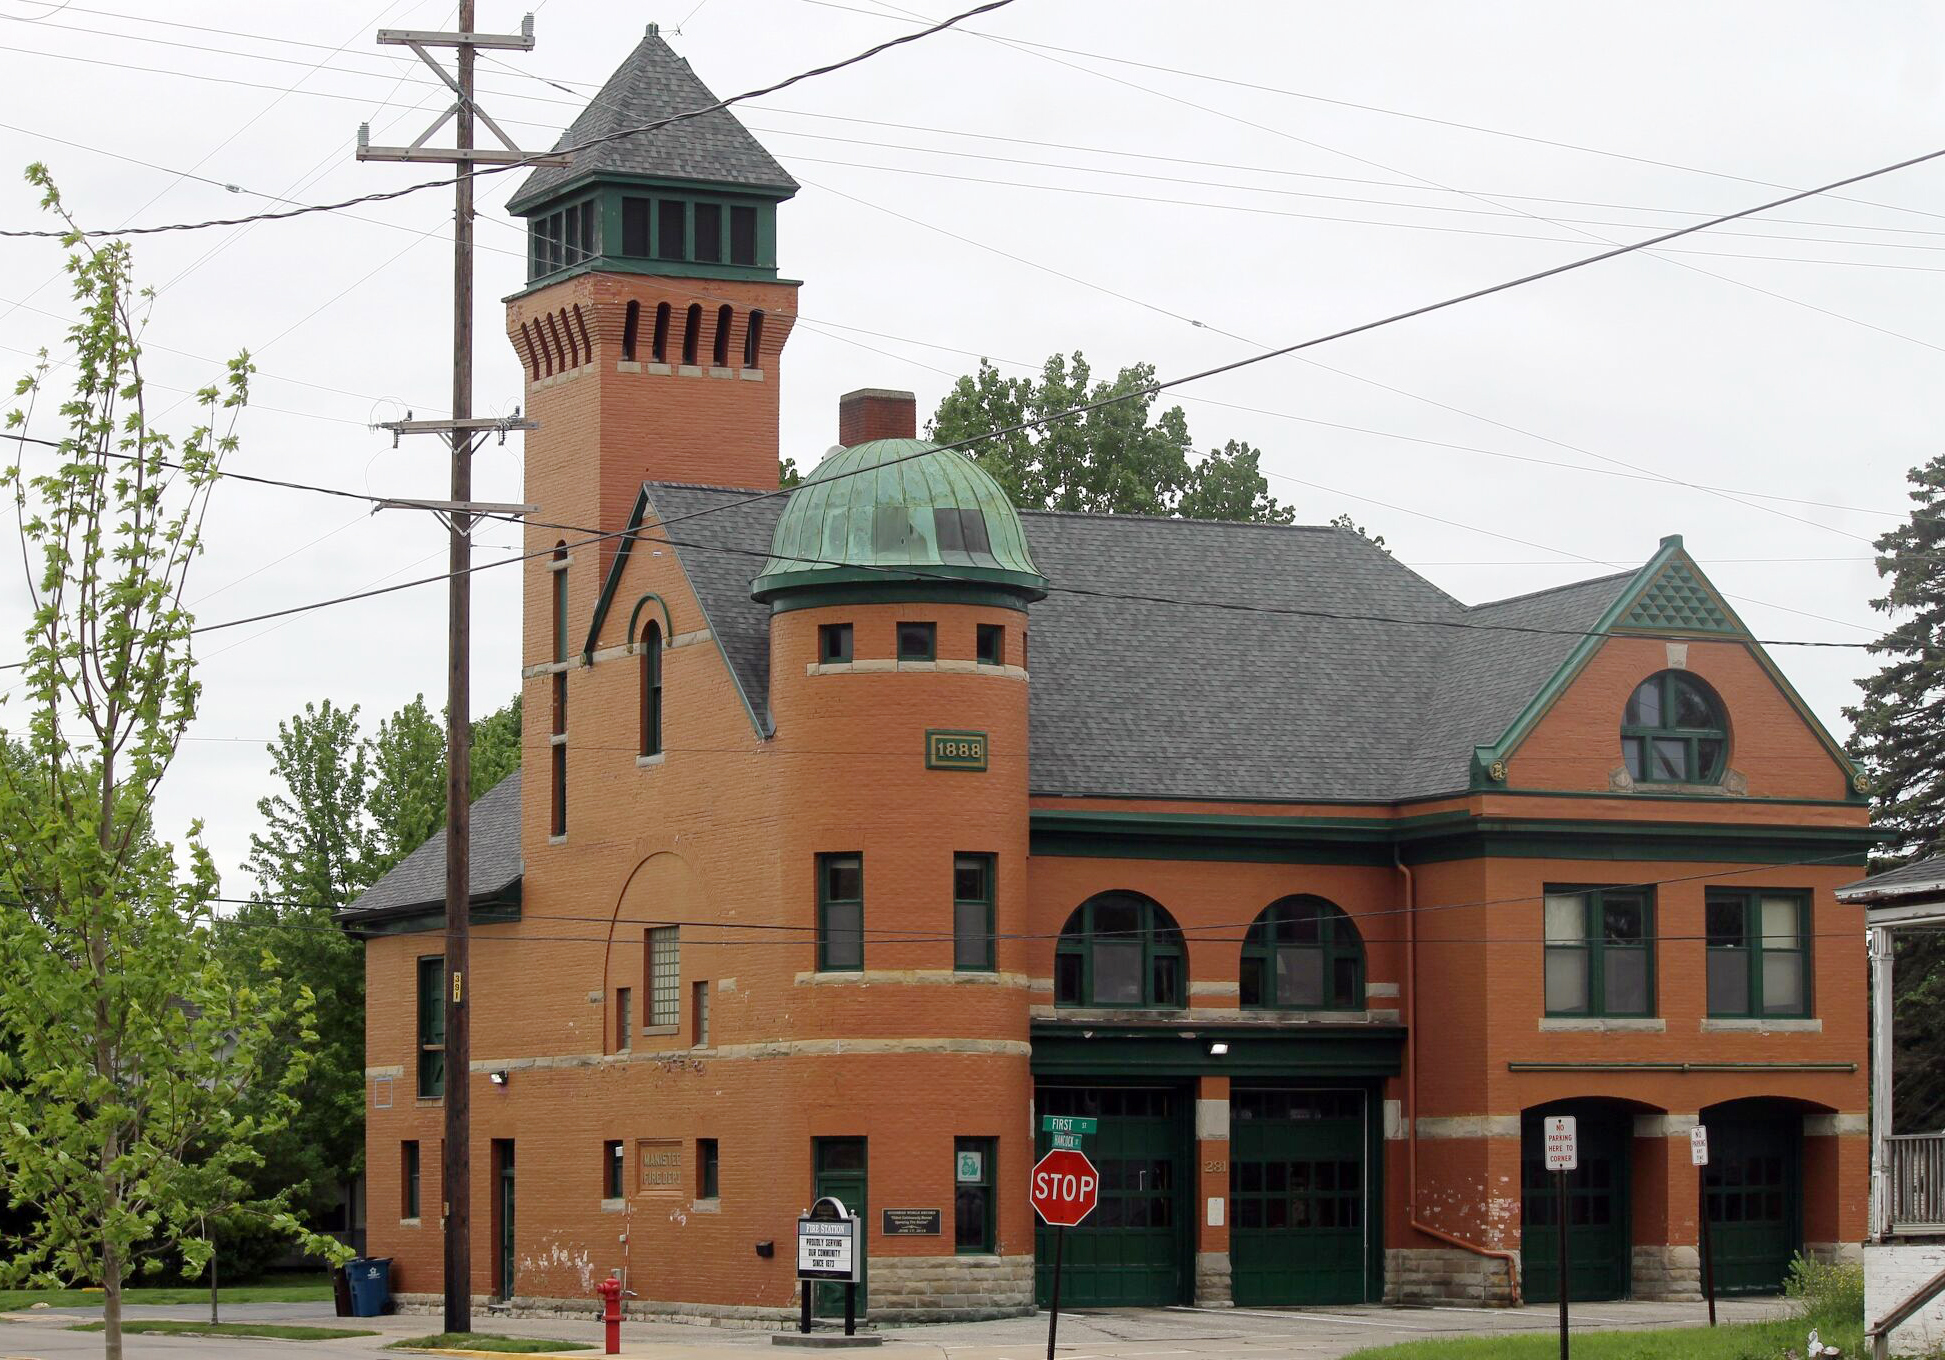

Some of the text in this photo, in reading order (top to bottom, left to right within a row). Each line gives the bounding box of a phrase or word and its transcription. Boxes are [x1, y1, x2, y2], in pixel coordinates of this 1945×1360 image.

[938, 742, 981, 757] 1888
[1052, 1118, 1073, 1131] FIRST
[1054, 1134, 1074, 1147] HANCOCK
[643, 1152, 681, 1167] MANISTEE
[1204, 1160, 1226, 1173] 281
[643, 1170, 681, 1184] FIRE DEPT
[1035, 1172, 1094, 1202] STOP
[806, 1223, 845, 1234] FIRE STATION
[806, 1238, 842, 1247] PROUDLY SERVING
[808, 1249, 841, 1257] OUR COMMUNITY
[812, 1259, 824, 1267] SINCE
